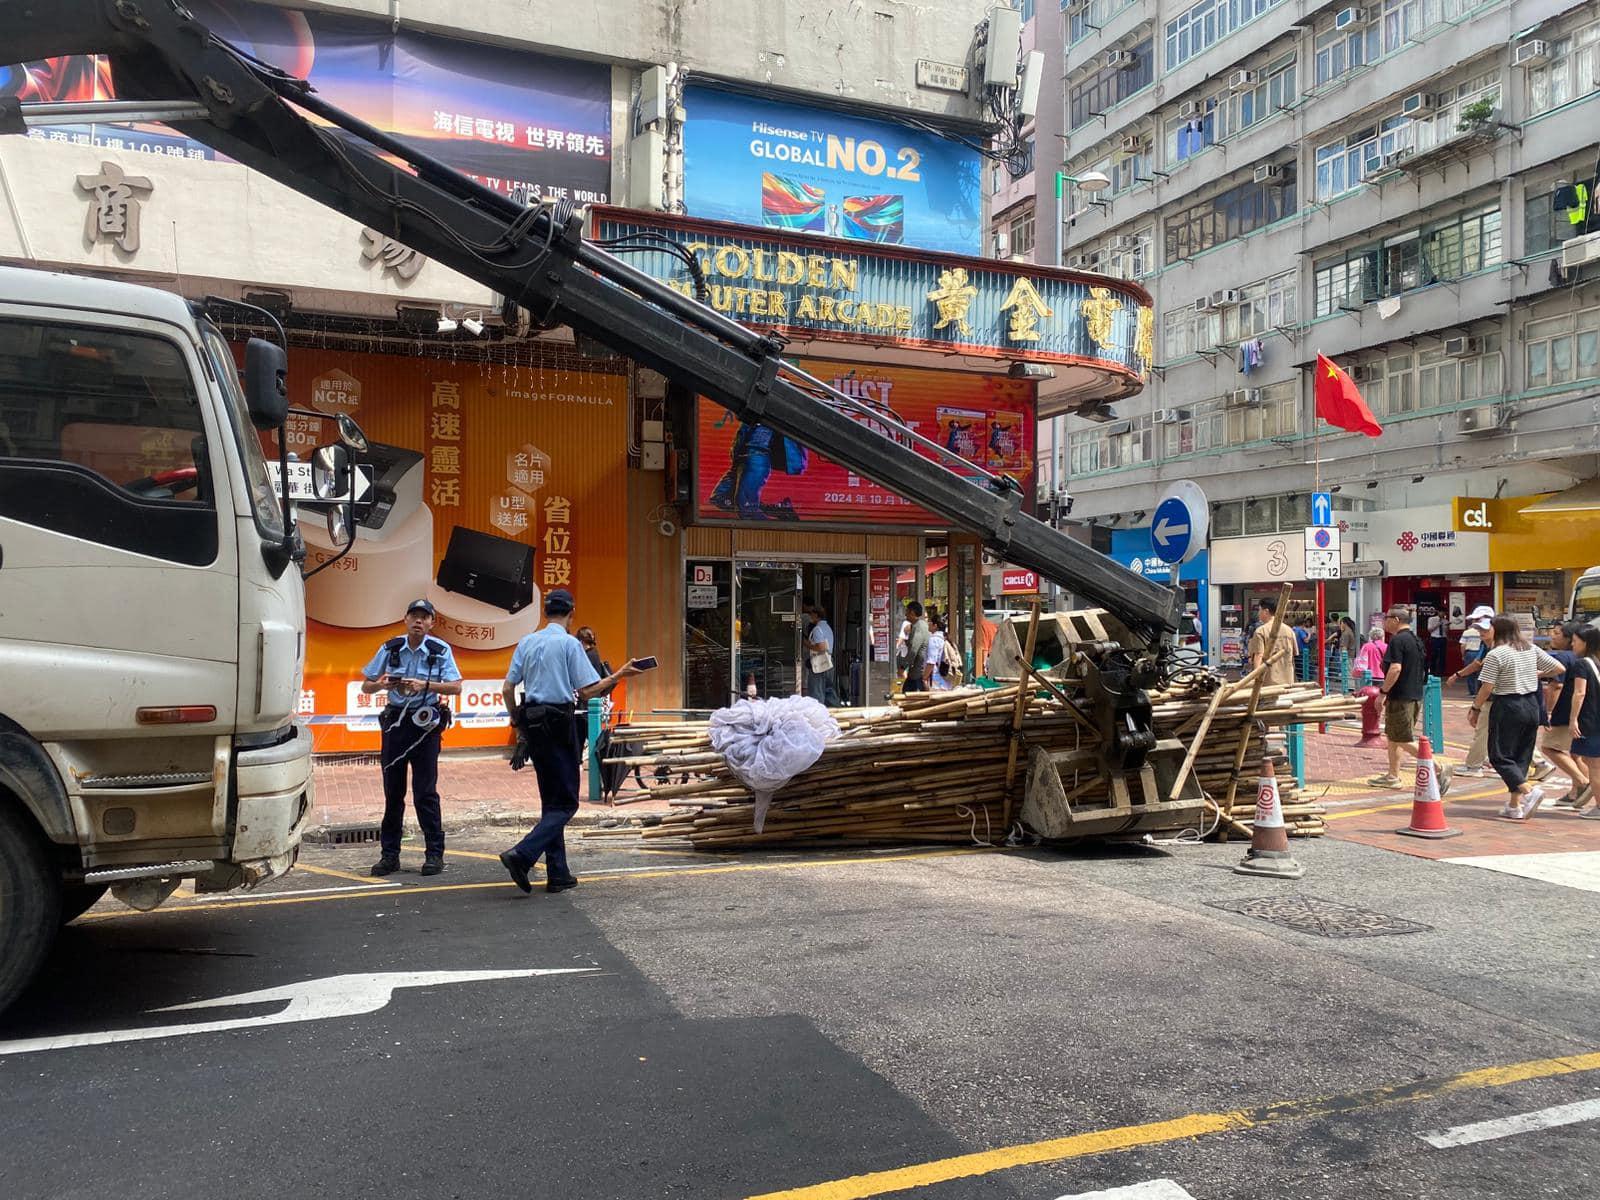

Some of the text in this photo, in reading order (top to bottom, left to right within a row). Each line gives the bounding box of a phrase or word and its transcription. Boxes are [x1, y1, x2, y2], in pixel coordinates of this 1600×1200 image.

[433, 110, 606, 157] 海信電視 世界領先
[751, 121, 826, 144] Hisense TV
[750, 139, 826, 168] GLOBAL
[826, 133, 922, 183] NO.2
[486, 177, 500, 189] TV
[506, 179, 541, 196] LEADS
[547, 186, 569, 200] THE
[574, 189, 608, 205] WORLD
[76, 160, 155, 253] 商
[685, 241, 859, 293] GOLDEN
[796, 294, 913, 330] ARCADE
[314, 390, 360, 406] NCR紙
[505, 388, 615, 406] imageFORMULA
[430, 380, 462, 507] 高速靈活
[514, 453, 544, 468] 名片
[513, 469, 544, 485] 適用
[500, 495, 526, 510] U型
[824, 492, 852, 504] 2024
[496, 512, 529, 528] 送紙
[1463, 502, 1493, 528] csl.
[543, 496, 571, 597] 省位設
[1266, 540, 1289, 577] 3
[1327, 552, 1334, 562] 7
[1003, 576, 1026, 586] CIRCLE
[1327, 567, 1339, 577] 12
[467, 692, 504, 708] OCR
